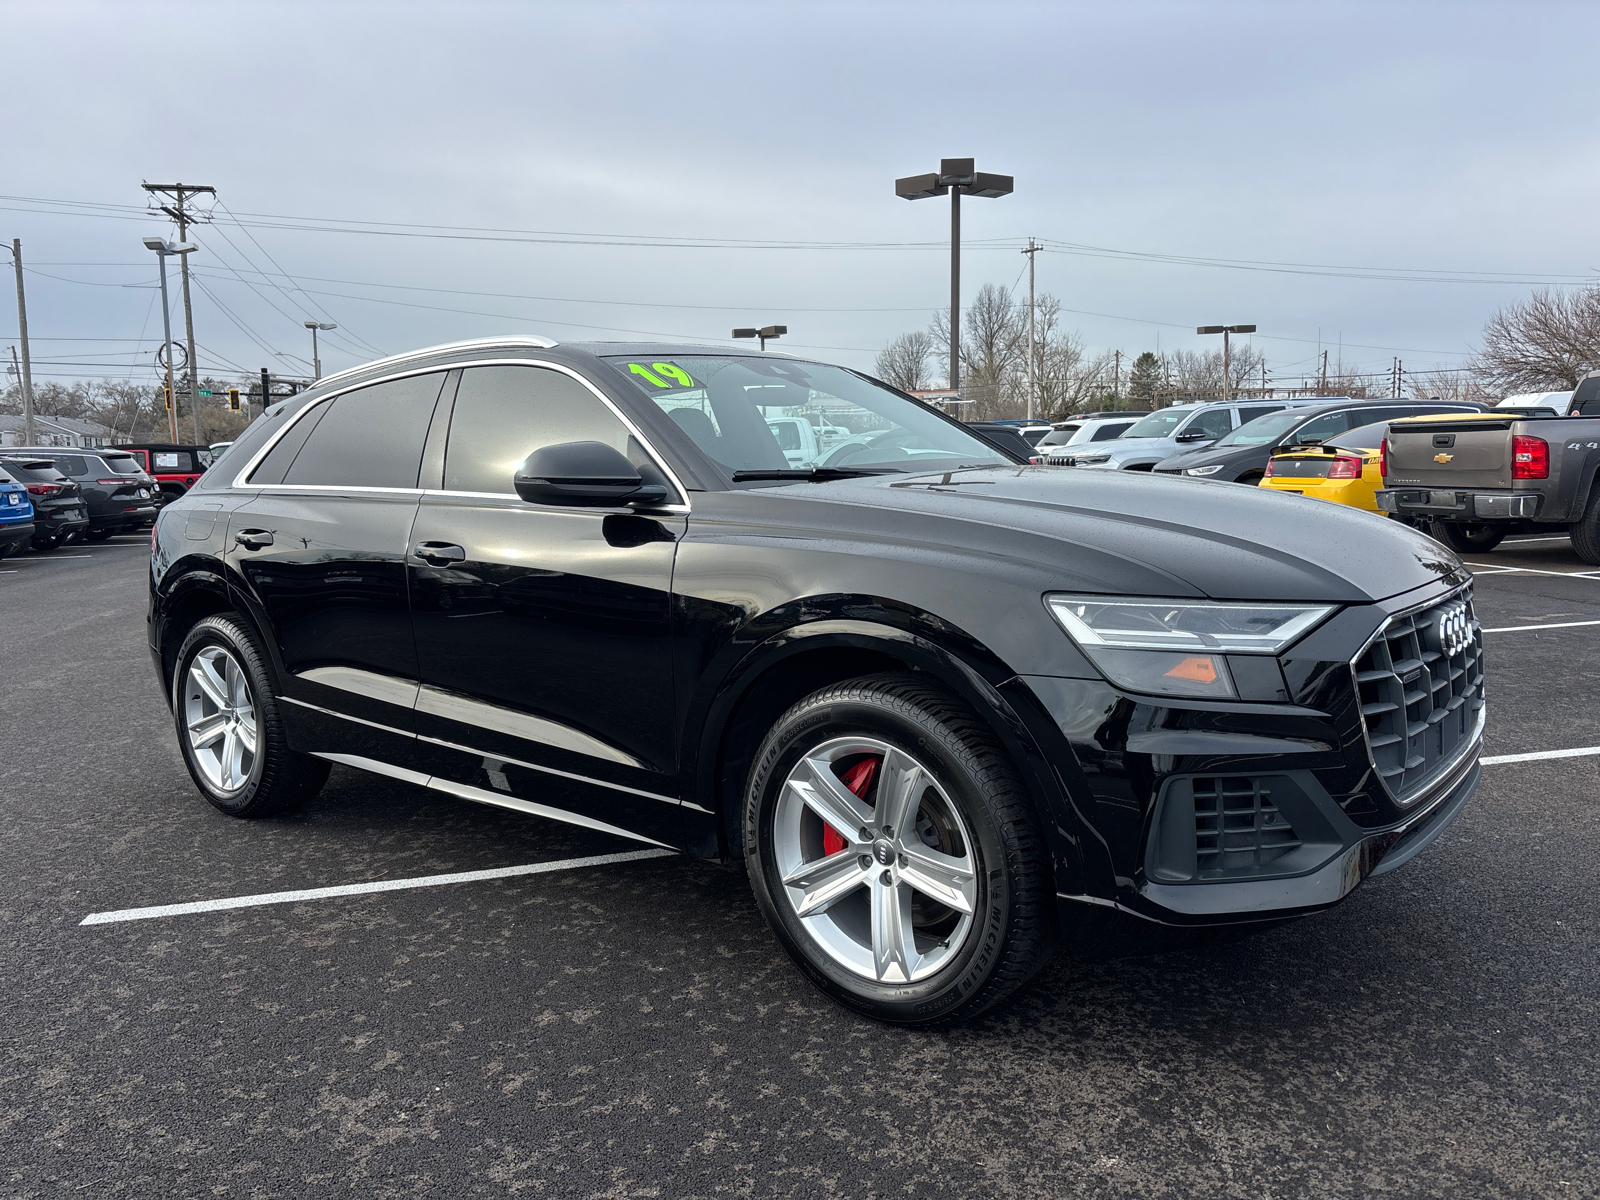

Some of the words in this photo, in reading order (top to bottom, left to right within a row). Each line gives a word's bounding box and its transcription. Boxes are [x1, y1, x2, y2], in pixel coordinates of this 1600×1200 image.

[628, 362, 694, 388] 19
[748, 744, 778, 825] MICHELIN
[962, 906, 1002, 991] MICHELIN
